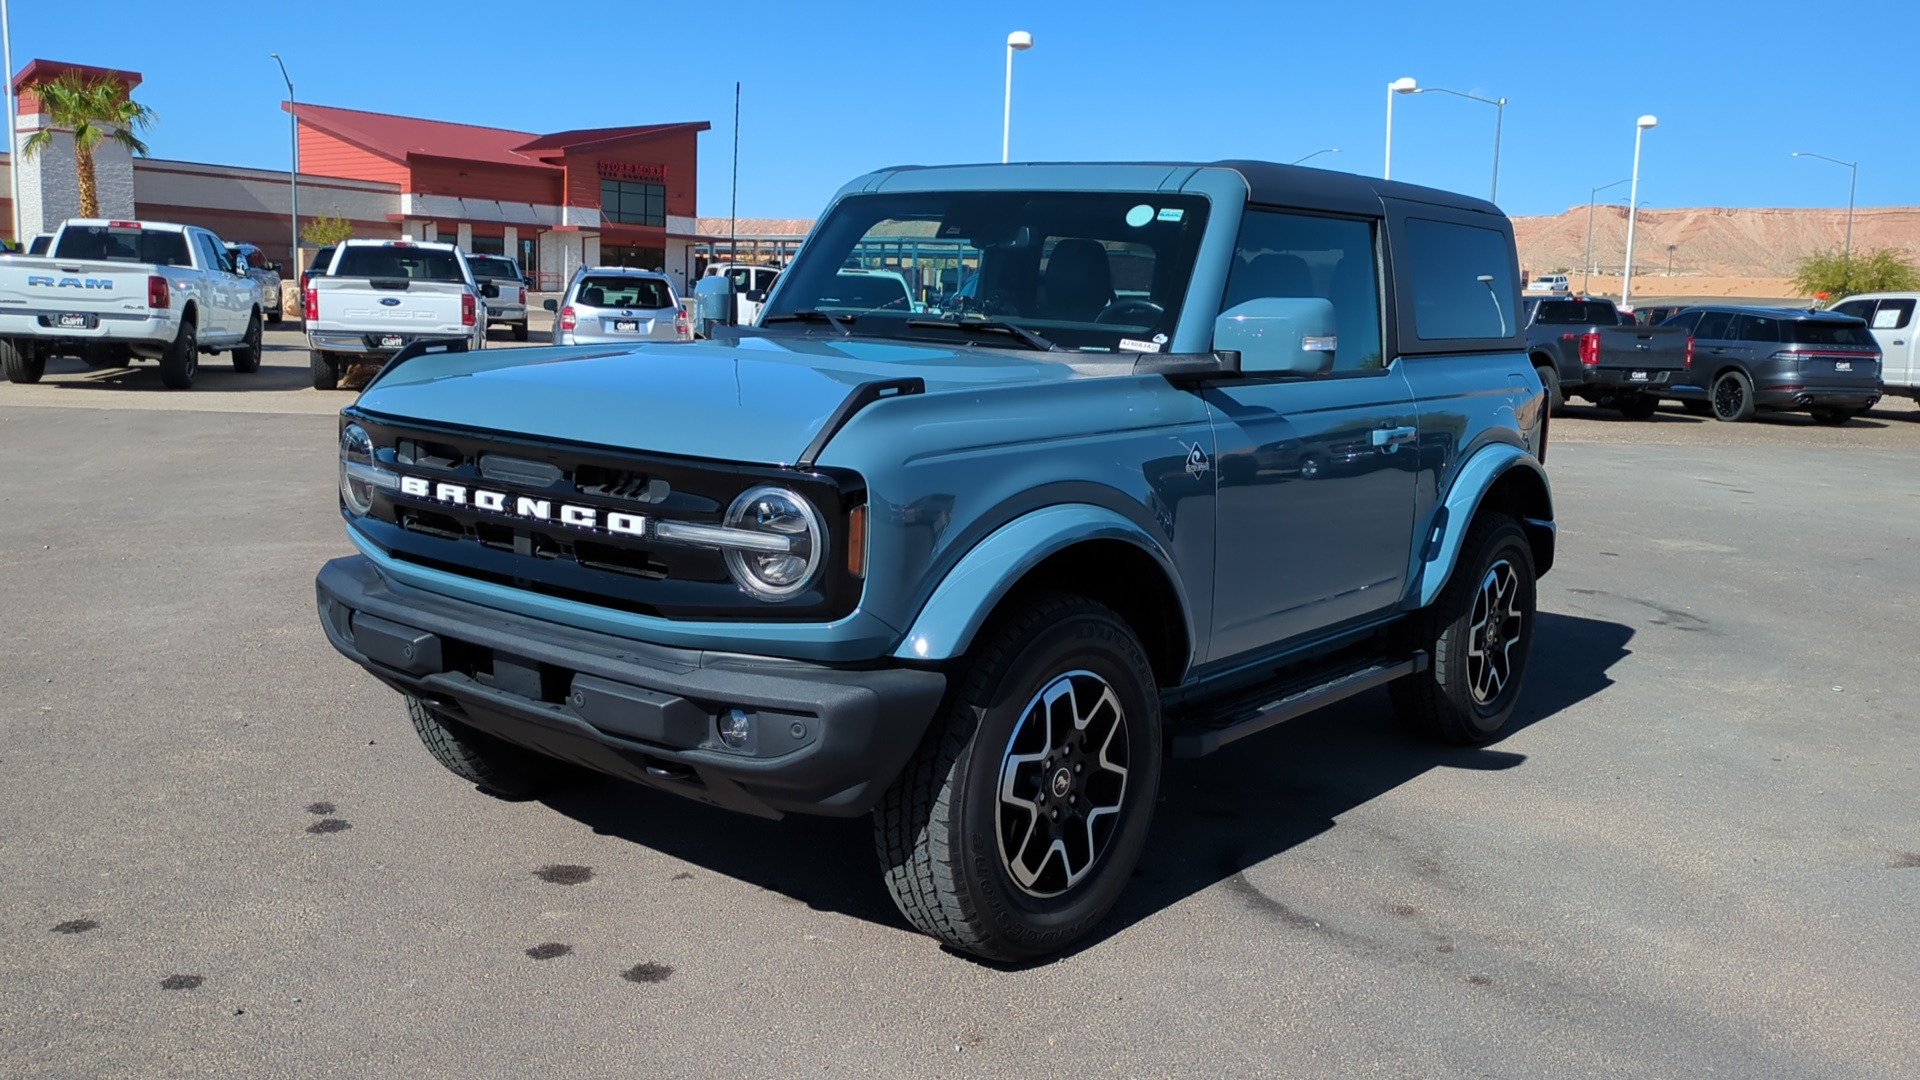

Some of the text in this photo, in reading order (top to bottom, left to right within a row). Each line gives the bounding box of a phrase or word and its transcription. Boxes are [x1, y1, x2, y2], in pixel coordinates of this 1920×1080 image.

[599, 160, 632, 173] STORE
[28, 275, 113, 290] RAM
[344, 308, 438, 320] F-150
[61, 316, 84, 325] Garff
[617, 321, 637, 330] Garff
[381, 337, 403, 346] Garff
[401, 476, 646, 536] BRONCO
